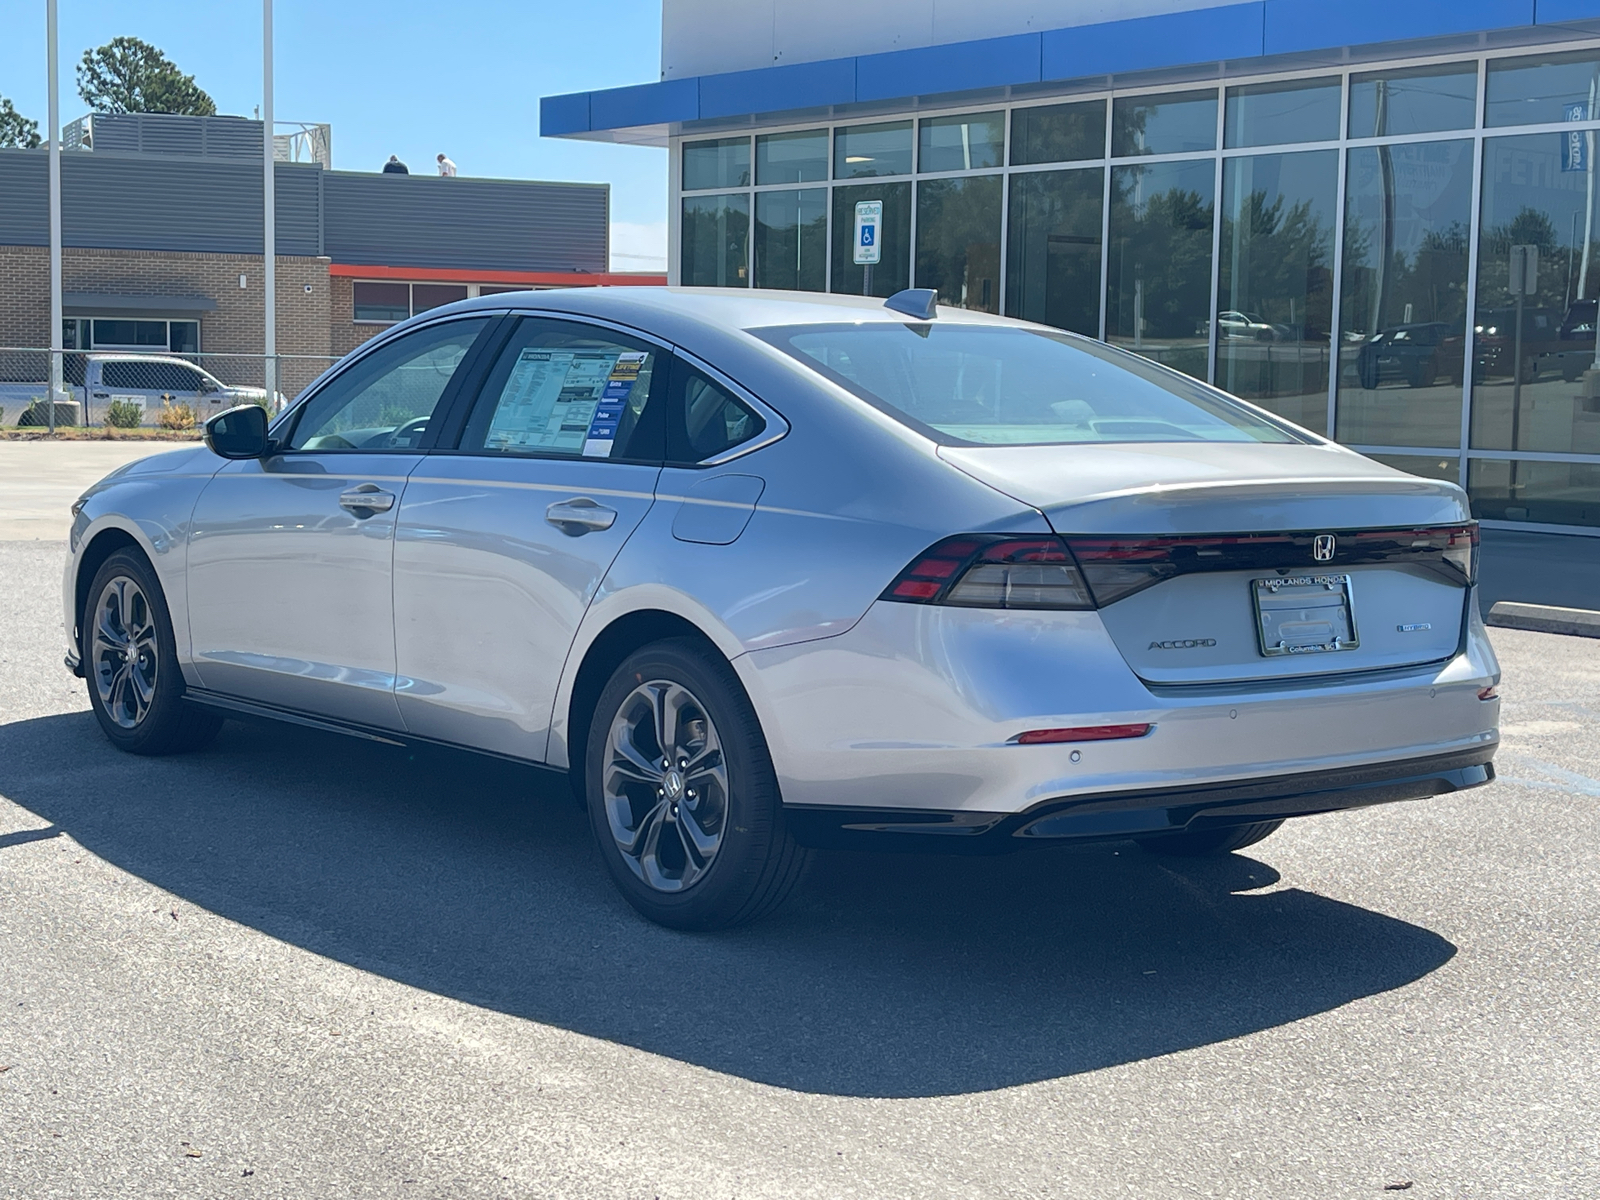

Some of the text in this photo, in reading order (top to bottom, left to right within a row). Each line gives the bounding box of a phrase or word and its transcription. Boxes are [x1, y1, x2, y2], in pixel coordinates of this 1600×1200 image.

[1265, 576, 1346, 587] MIDLANDS HONDA
[1148, 638, 1217, 650] ACCORD
